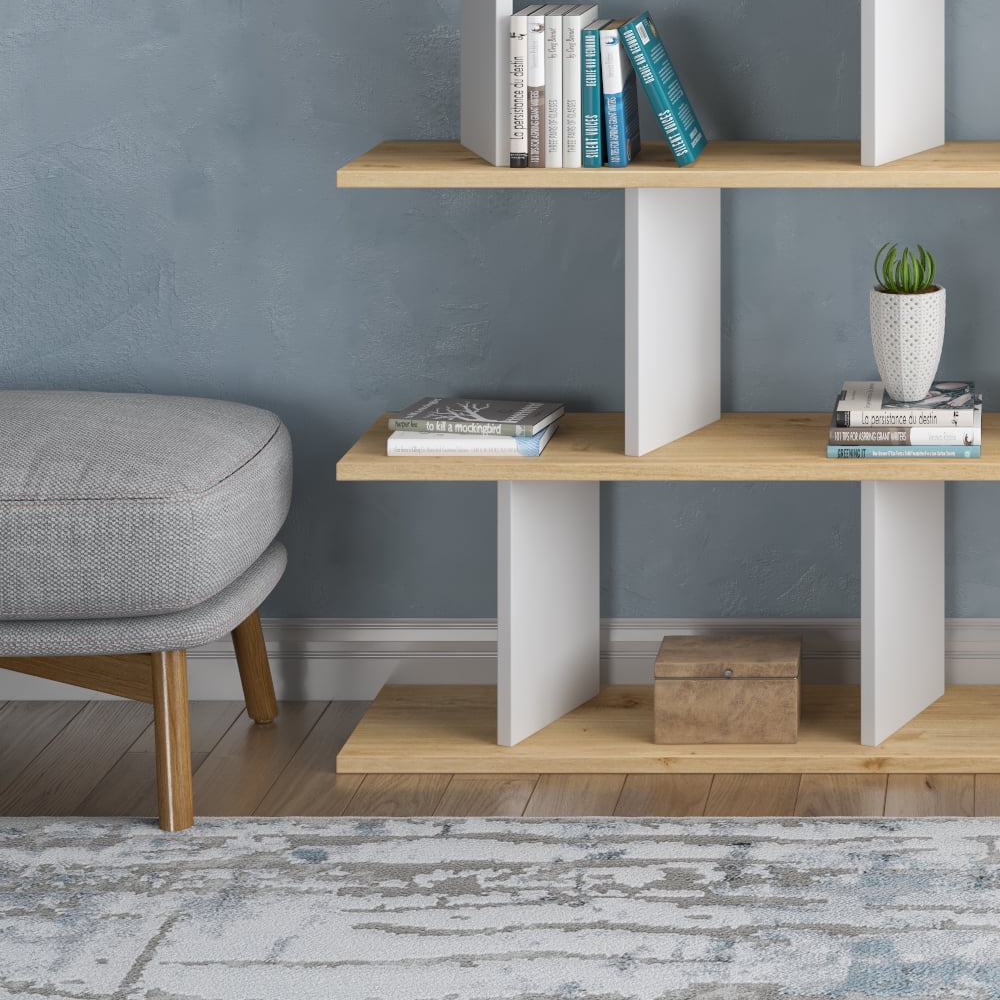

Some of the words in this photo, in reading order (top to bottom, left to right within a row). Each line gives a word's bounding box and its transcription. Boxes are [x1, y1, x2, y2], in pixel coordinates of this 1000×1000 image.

[510, 56, 524, 77] destin
[510, 90, 526, 130] persistance
[585, 114, 599, 136] VOICES
[658, 109, 678, 134] VOICES
[510, 131, 524, 140] La
[668, 132, 689, 157] SILENT
[585, 137, 599, 159] SILENT
[426, 421, 434, 431] to
[436, 420, 446, 431] kill
[447, 423, 453, 432] a
[455, 422, 502, 436] mockingbird
[862, 411, 869, 425] La
[871, 411, 907, 428] persistance
[918, 411, 938, 425] destin
